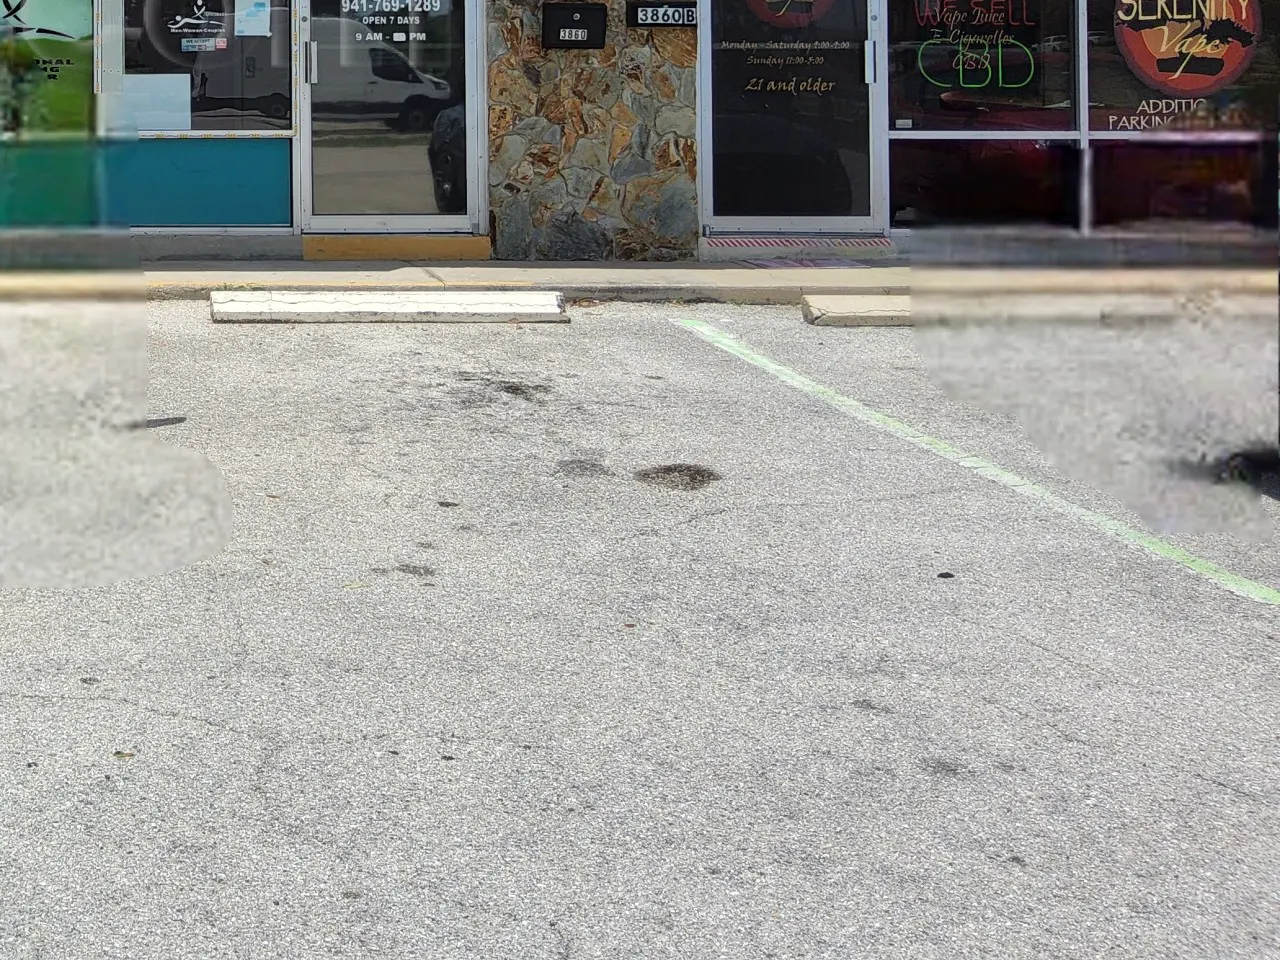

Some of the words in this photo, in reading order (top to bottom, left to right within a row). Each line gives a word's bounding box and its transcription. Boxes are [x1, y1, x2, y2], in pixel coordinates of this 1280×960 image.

[362, 16, 387, 25] OPEN
[389, 16, 395, 25] 7
[397, 16, 420, 25] DAYS
[355, 32, 362, 41] 9
[365, 32, 383, 41] AM
[409, 32, 427, 41] PM
[560, 29, 587, 40] 3860
[720, 39, 758, 53] Monday
[765, 39, 811, 53] Saturday
[1156, 22, 1226, 80] Vape
[746, 55, 784, 69] Sunday
[918, 38, 1035, 87] CBD
[744, 78, 764, 91] 21
[766, 77, 798, 96] and
[799, 77, 836, 96] older
